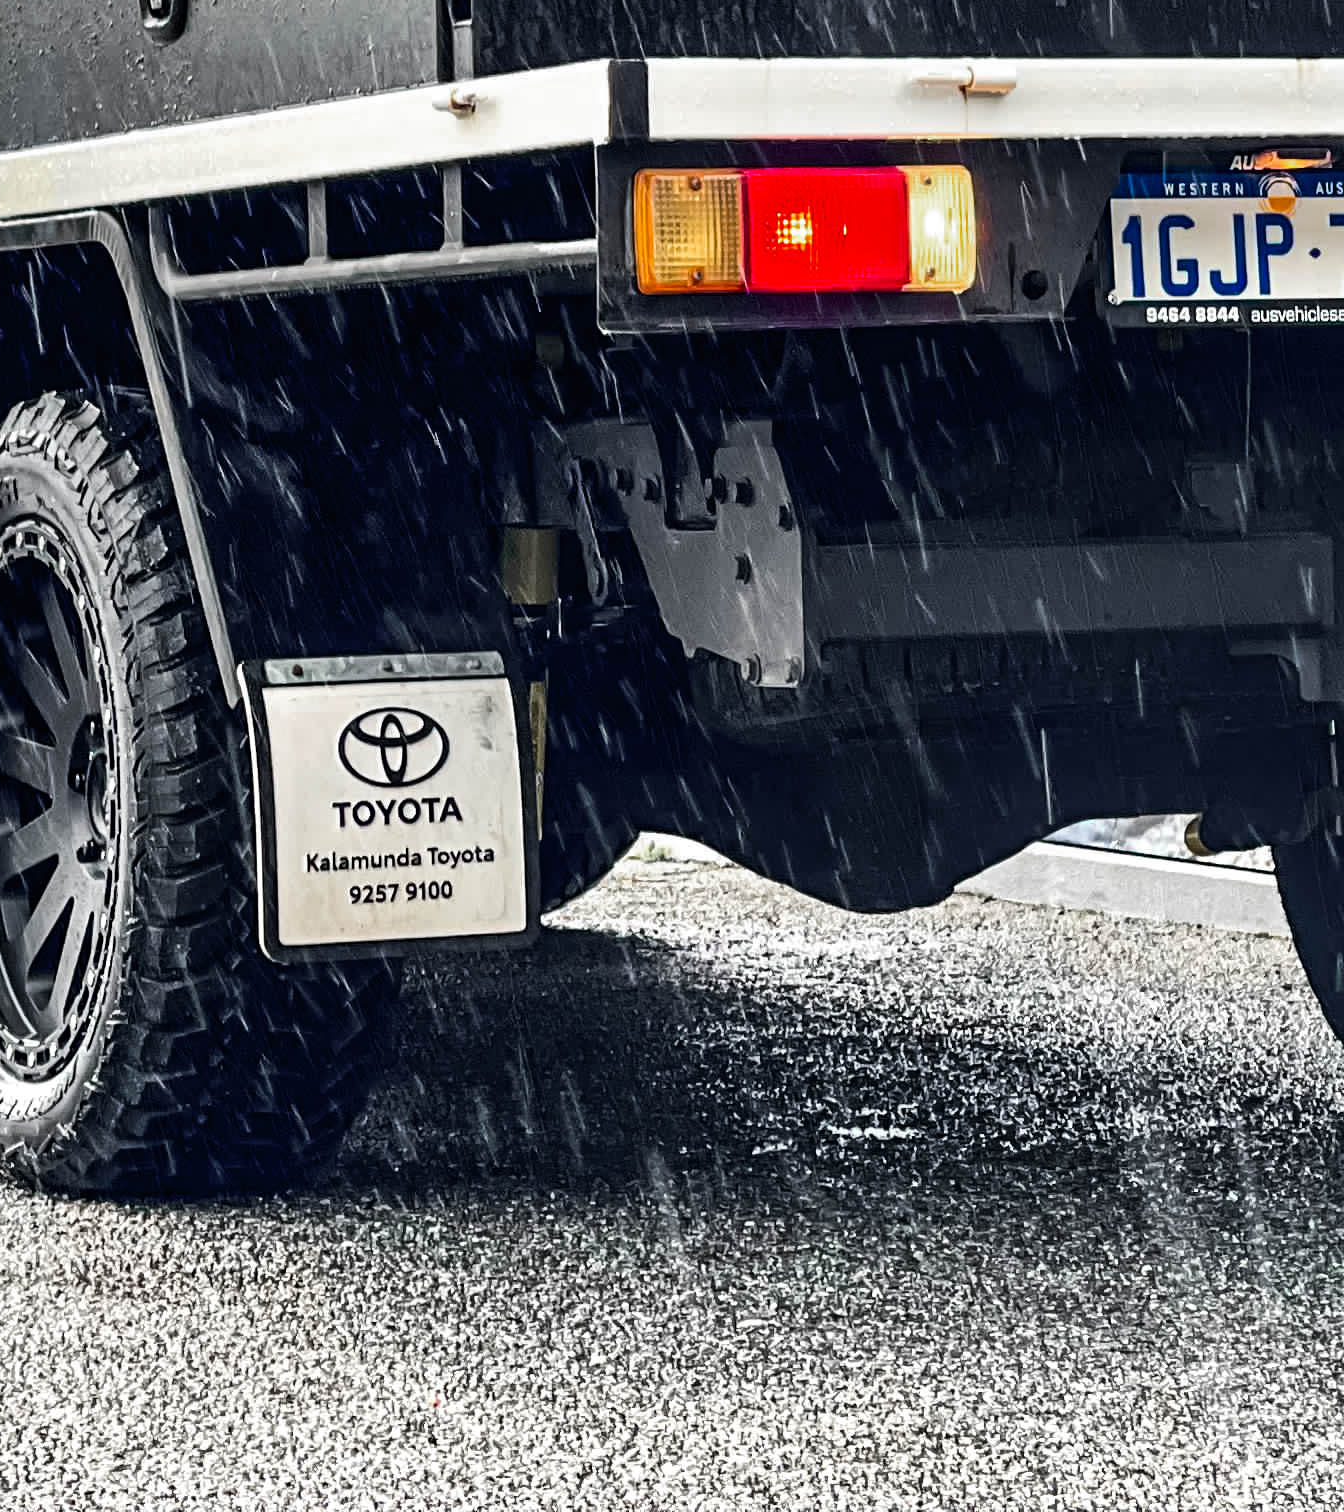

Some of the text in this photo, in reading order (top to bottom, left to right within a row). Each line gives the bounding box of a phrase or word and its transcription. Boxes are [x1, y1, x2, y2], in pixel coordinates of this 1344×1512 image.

[1164, 181, 1244, 196] WESTERN
[1146, 306, 1193, 323] 9464
[1196, 306, 1240, 322] 8844
[332, 797, 463, 829] TOYOTA
[306, 846, 495, 874] Kalamunda Toyota
[349, 880, 453, 904] 9257 9100
